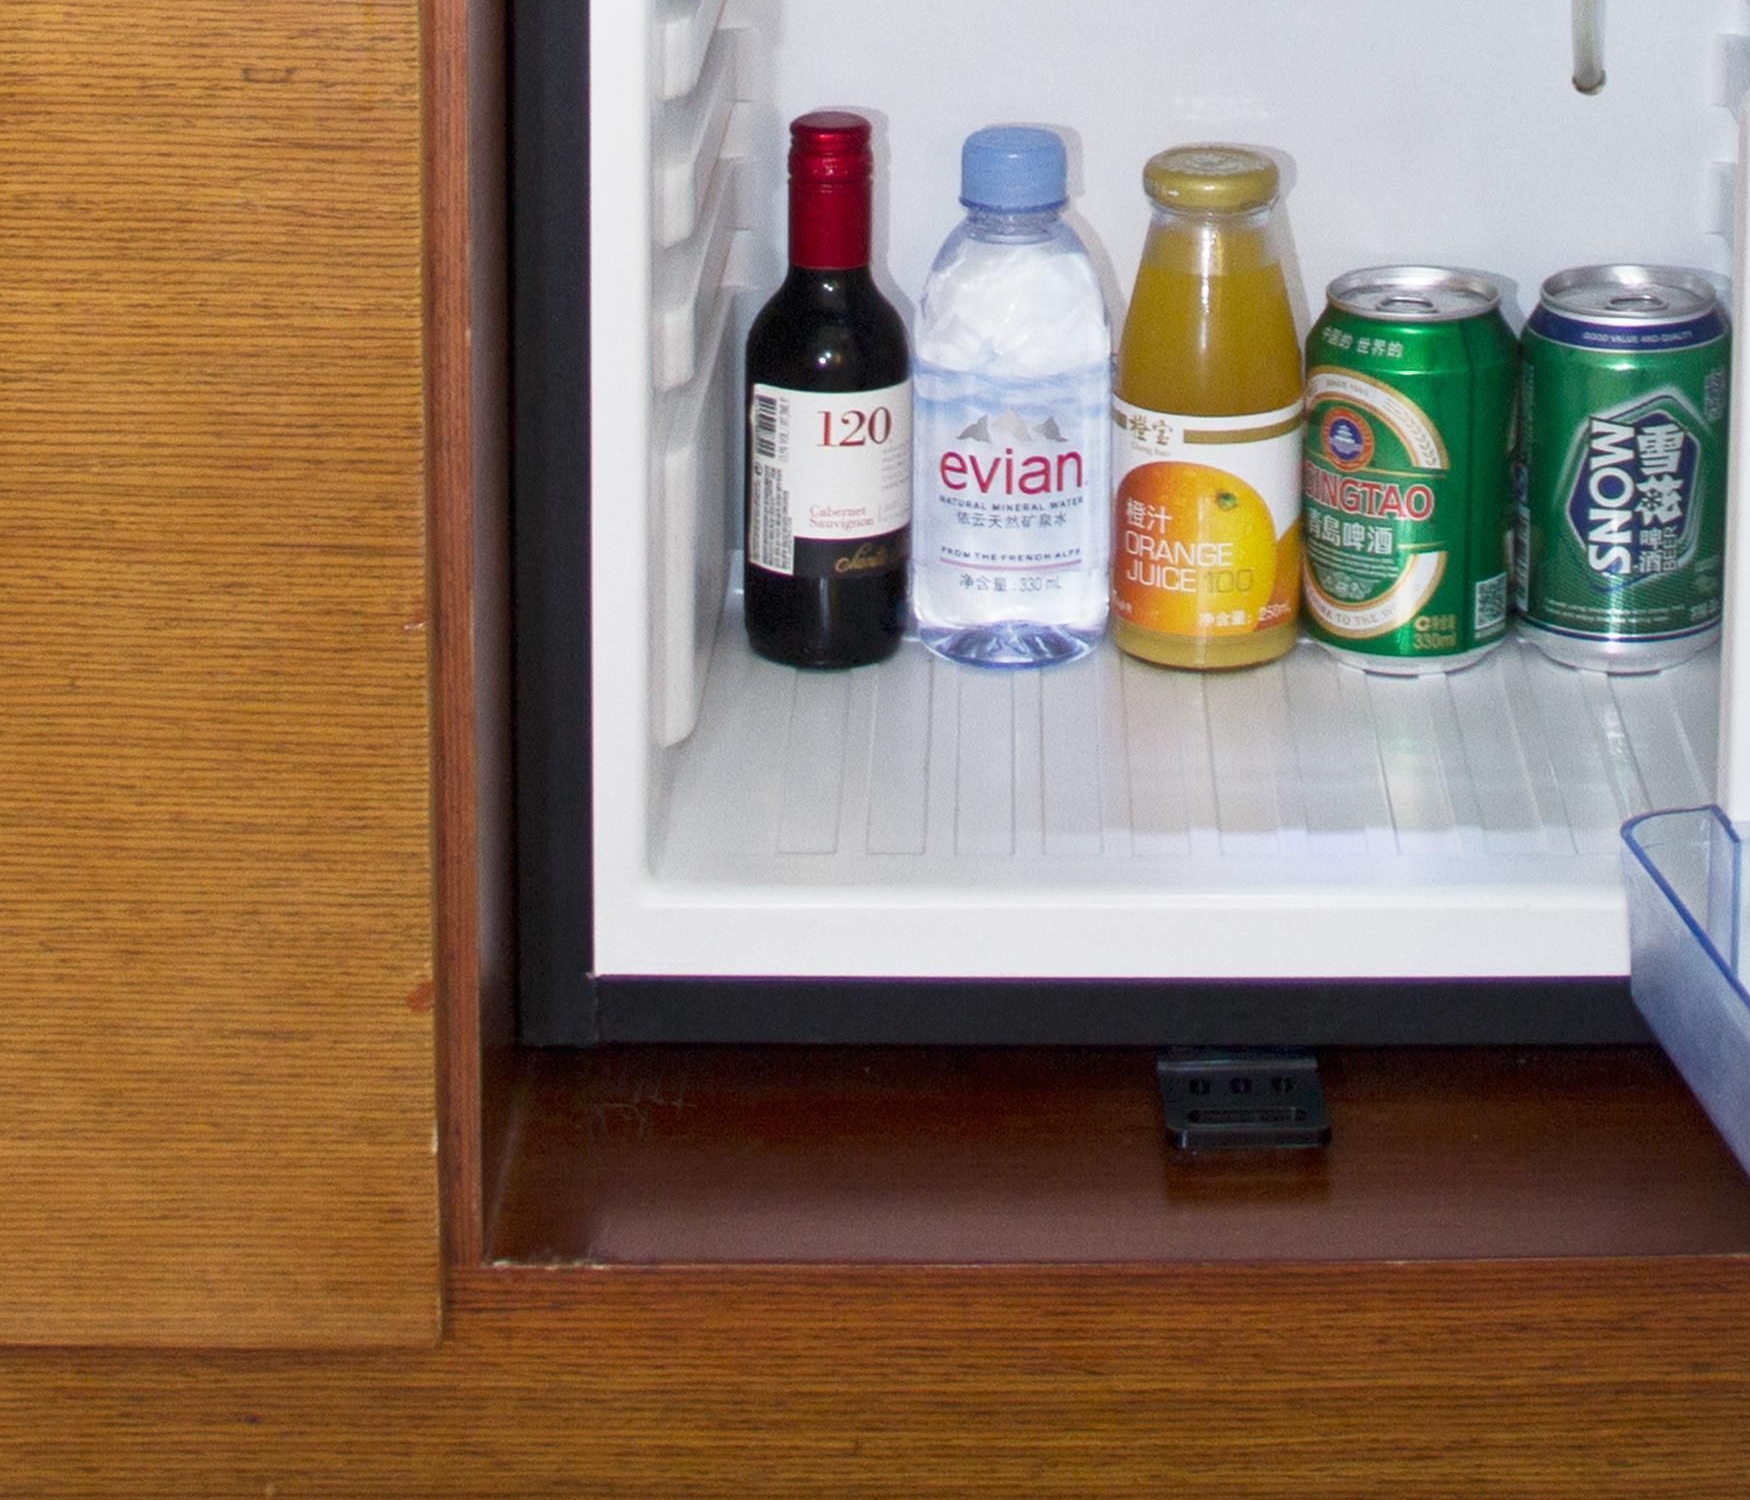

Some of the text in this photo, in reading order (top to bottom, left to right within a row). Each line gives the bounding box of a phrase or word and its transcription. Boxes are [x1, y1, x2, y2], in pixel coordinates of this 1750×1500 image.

[817, 406, 892, 448] 120
[940, 448, 1083, 496] evian
[809, 504, 867, 519] Cabernet
[939, 494, 1084, 513] NATURAL MINERAL WATER
[1588, 419, 1636, 574] SNOW
[809, 517, 874, 532] Sauvignon
[956, 511, 1068, 529] 依云天然矿泉水
[1126, 498, 1173, 535] 橙汁
[941, 545, 971, 559] FROM
[974, 552, 997, 561] THE
[1000, 554, 1052, 562] FRENCH
[1125, 530, 1233, 567] ORANGE
[1663, 525, 1679, 572] BEER
[1127, 559, 1254, 594] JUICE 100
